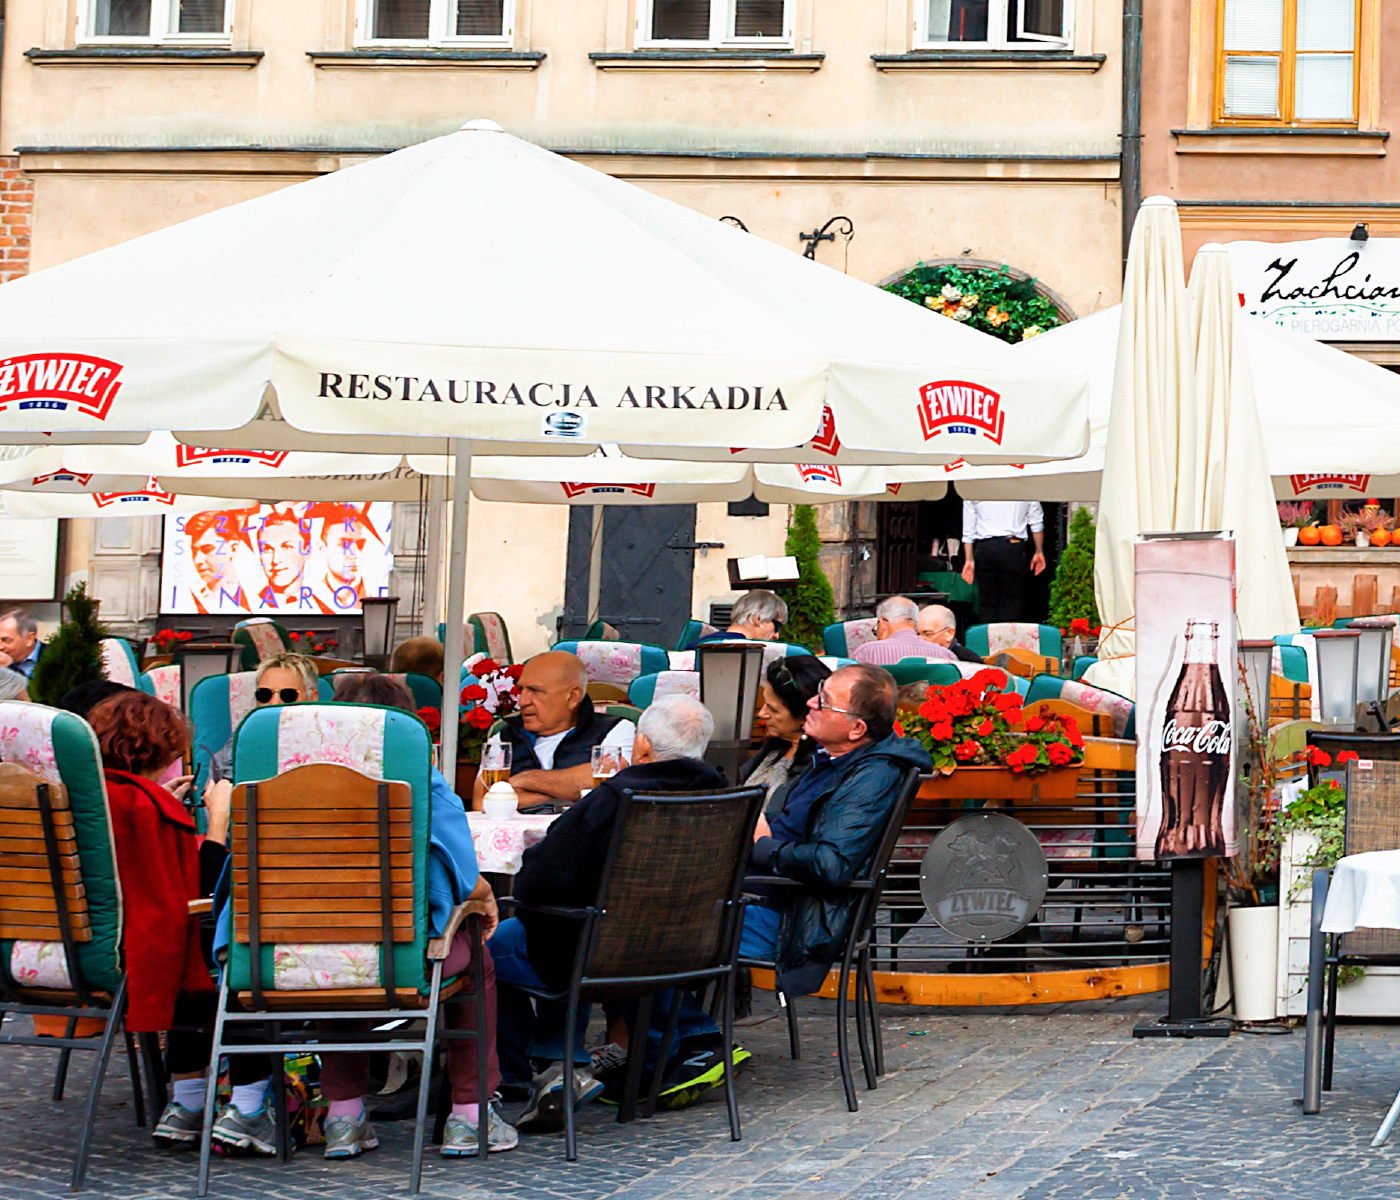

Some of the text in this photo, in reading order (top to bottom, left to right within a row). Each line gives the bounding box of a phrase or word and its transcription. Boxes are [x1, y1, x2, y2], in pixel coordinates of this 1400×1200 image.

[1290, 318, 1381, 333] PIEROGARNIA
[0, 359, 112, 398] ŻYWIEC
[318, 371, 790, 412] RESTAURACJA ARKADIA
[926, 385, 995, 425] ŻYWIEC
[1161, 718, 1231, 755] Coca-Cola
